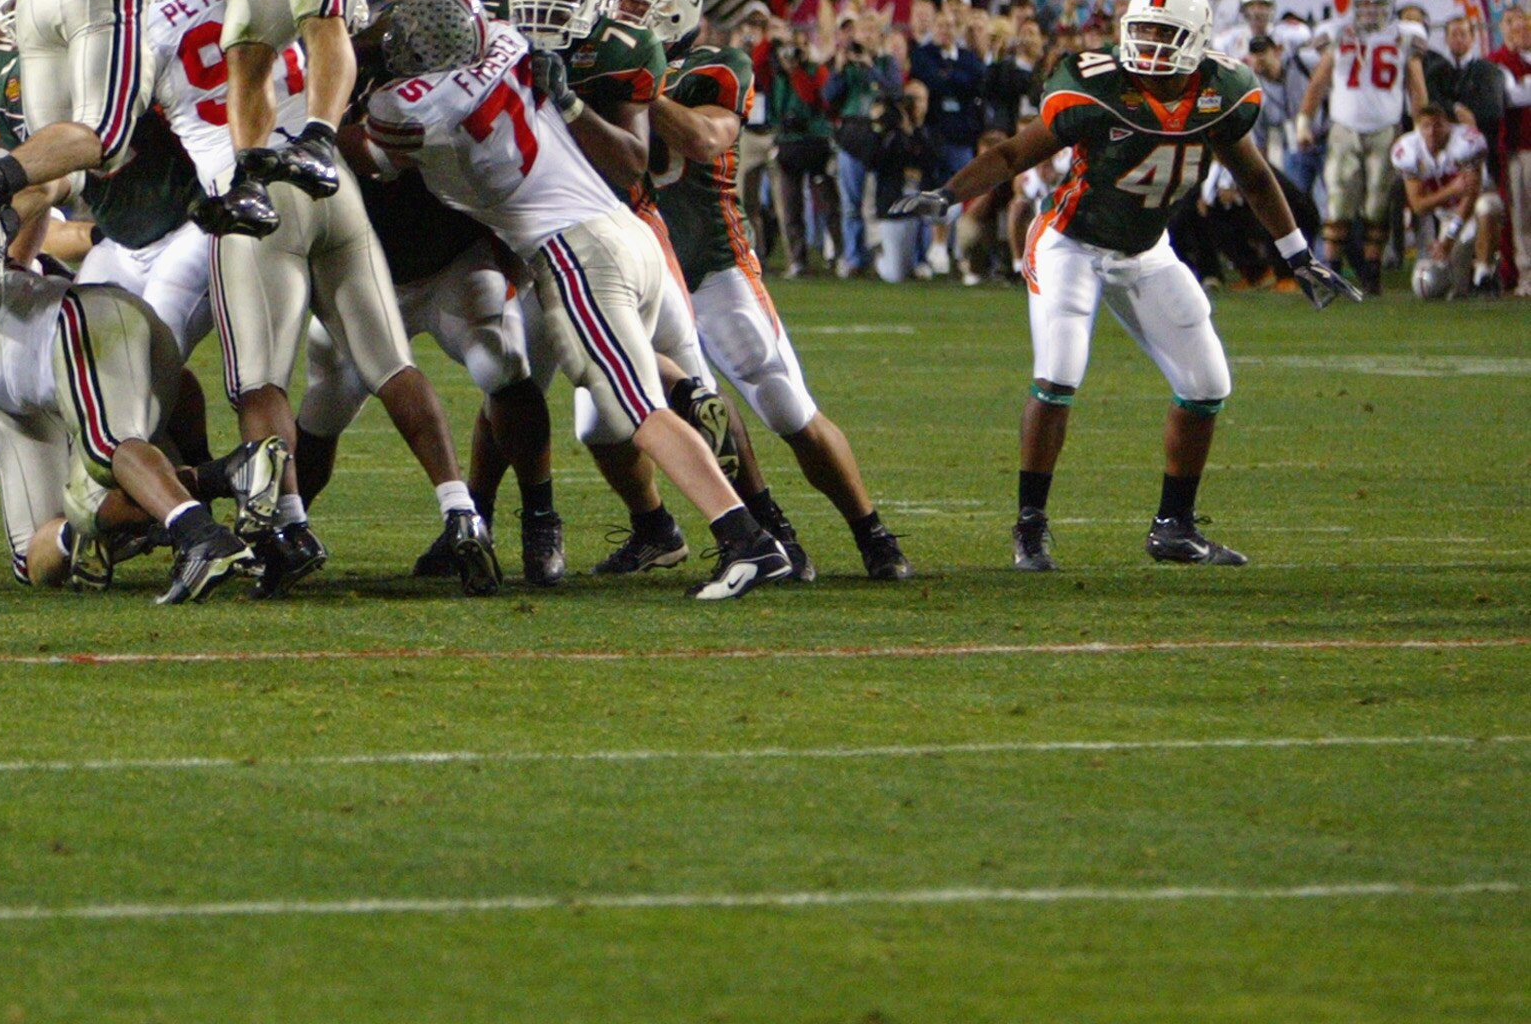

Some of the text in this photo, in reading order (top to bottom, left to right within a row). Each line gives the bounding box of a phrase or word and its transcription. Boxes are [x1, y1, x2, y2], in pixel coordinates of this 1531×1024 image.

[452, 33, 522, 98] FRASER
[1340, 43, 1399, 91] 76
[1115, 143, 1205, 209] 41
